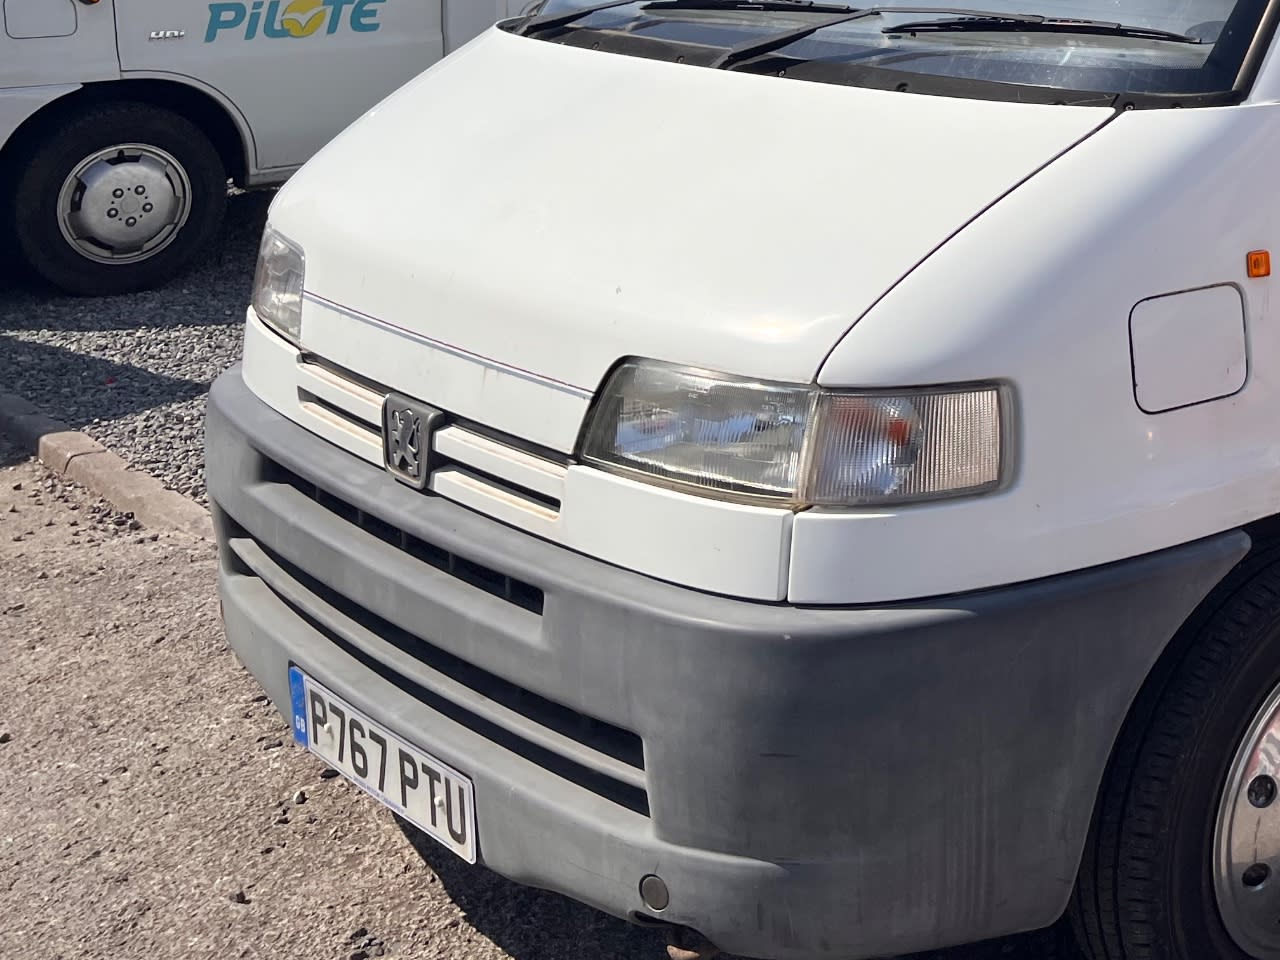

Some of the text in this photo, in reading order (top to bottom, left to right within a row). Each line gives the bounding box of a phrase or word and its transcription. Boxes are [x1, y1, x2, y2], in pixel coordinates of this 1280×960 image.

[295, 714, 306, 733] GB
[309, 689, 467, 846] P767 PTU
